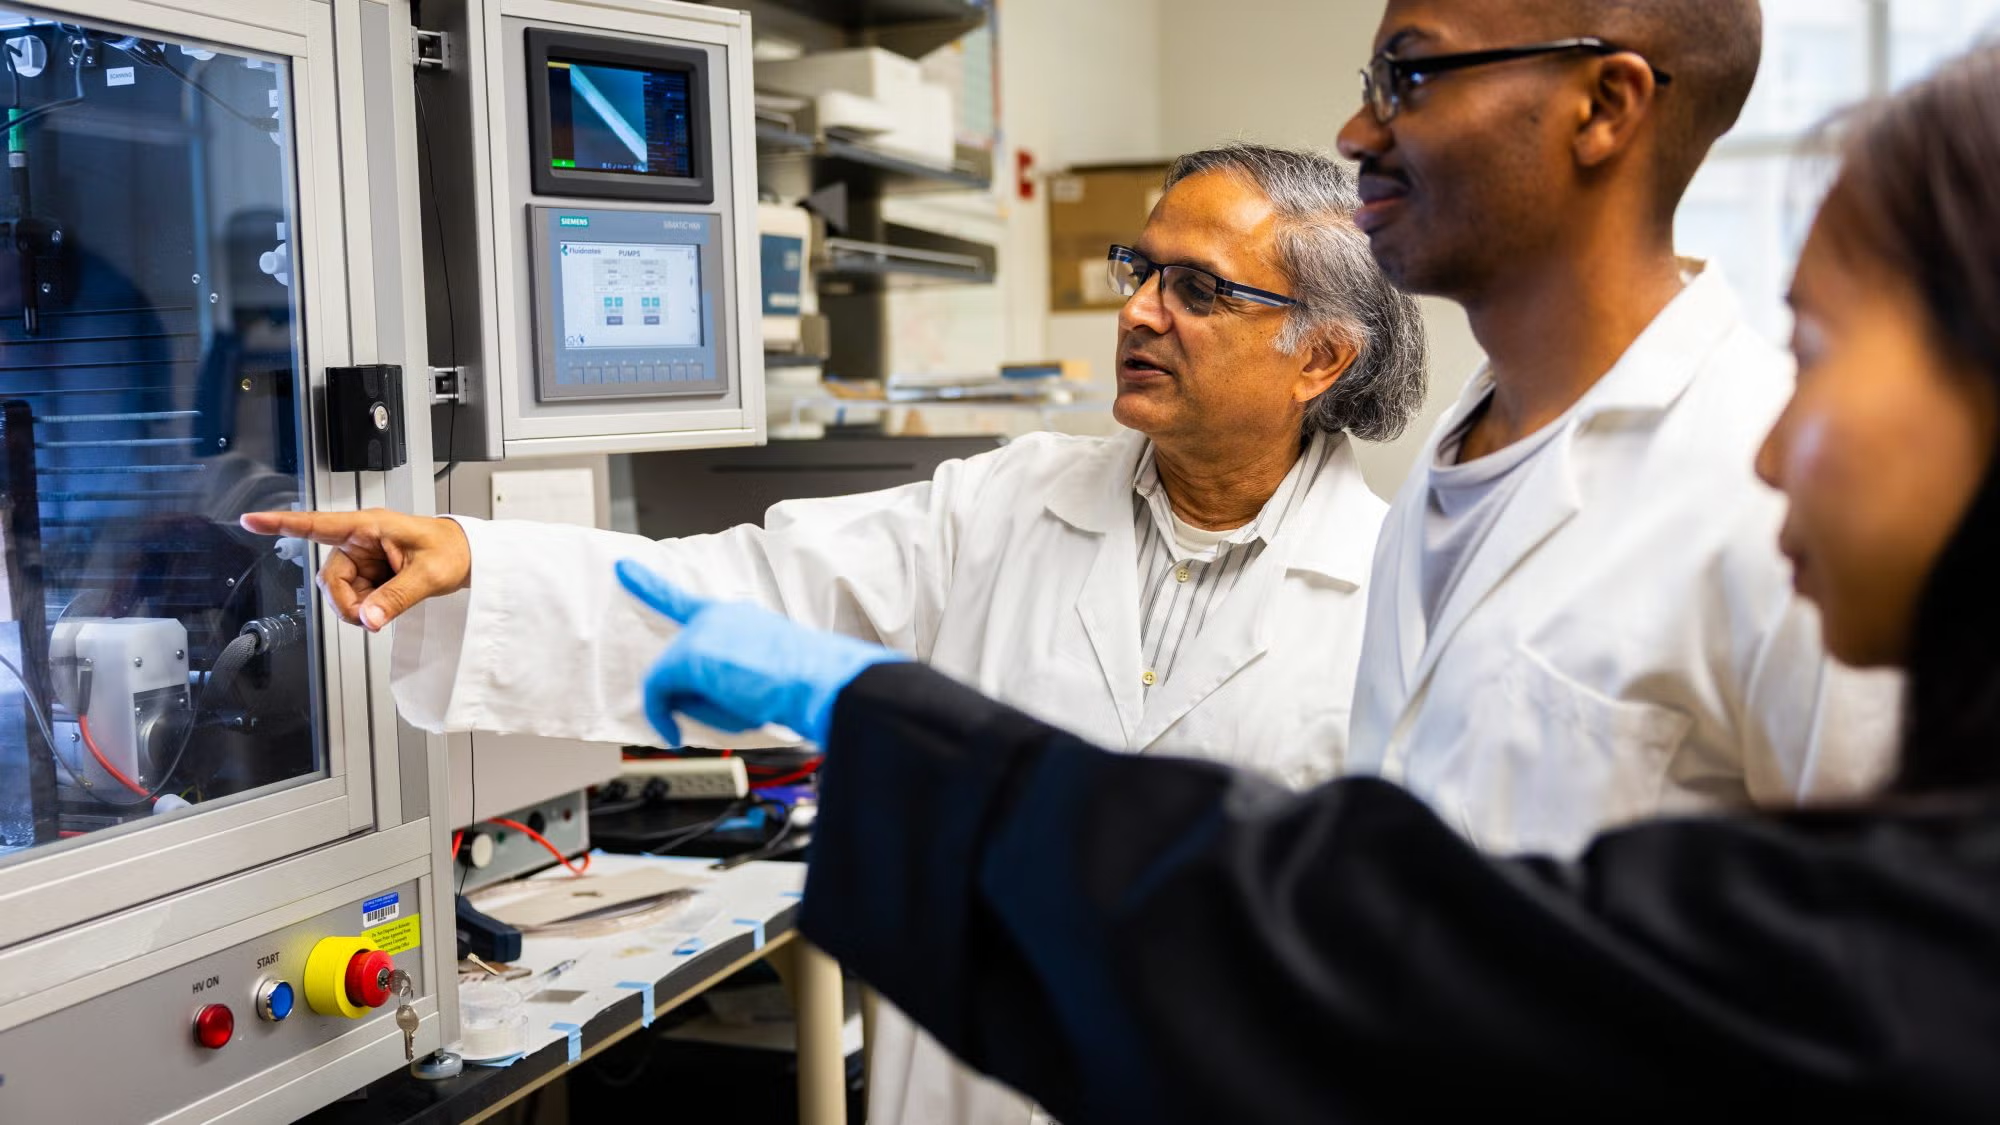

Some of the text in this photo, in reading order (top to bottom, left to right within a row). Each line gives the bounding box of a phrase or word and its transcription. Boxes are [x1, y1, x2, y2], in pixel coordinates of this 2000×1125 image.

[561, 217, 588, 226] SIEMENS
[256, 951, 280, 969] START
[192, 976, 219, 994] HV ON
